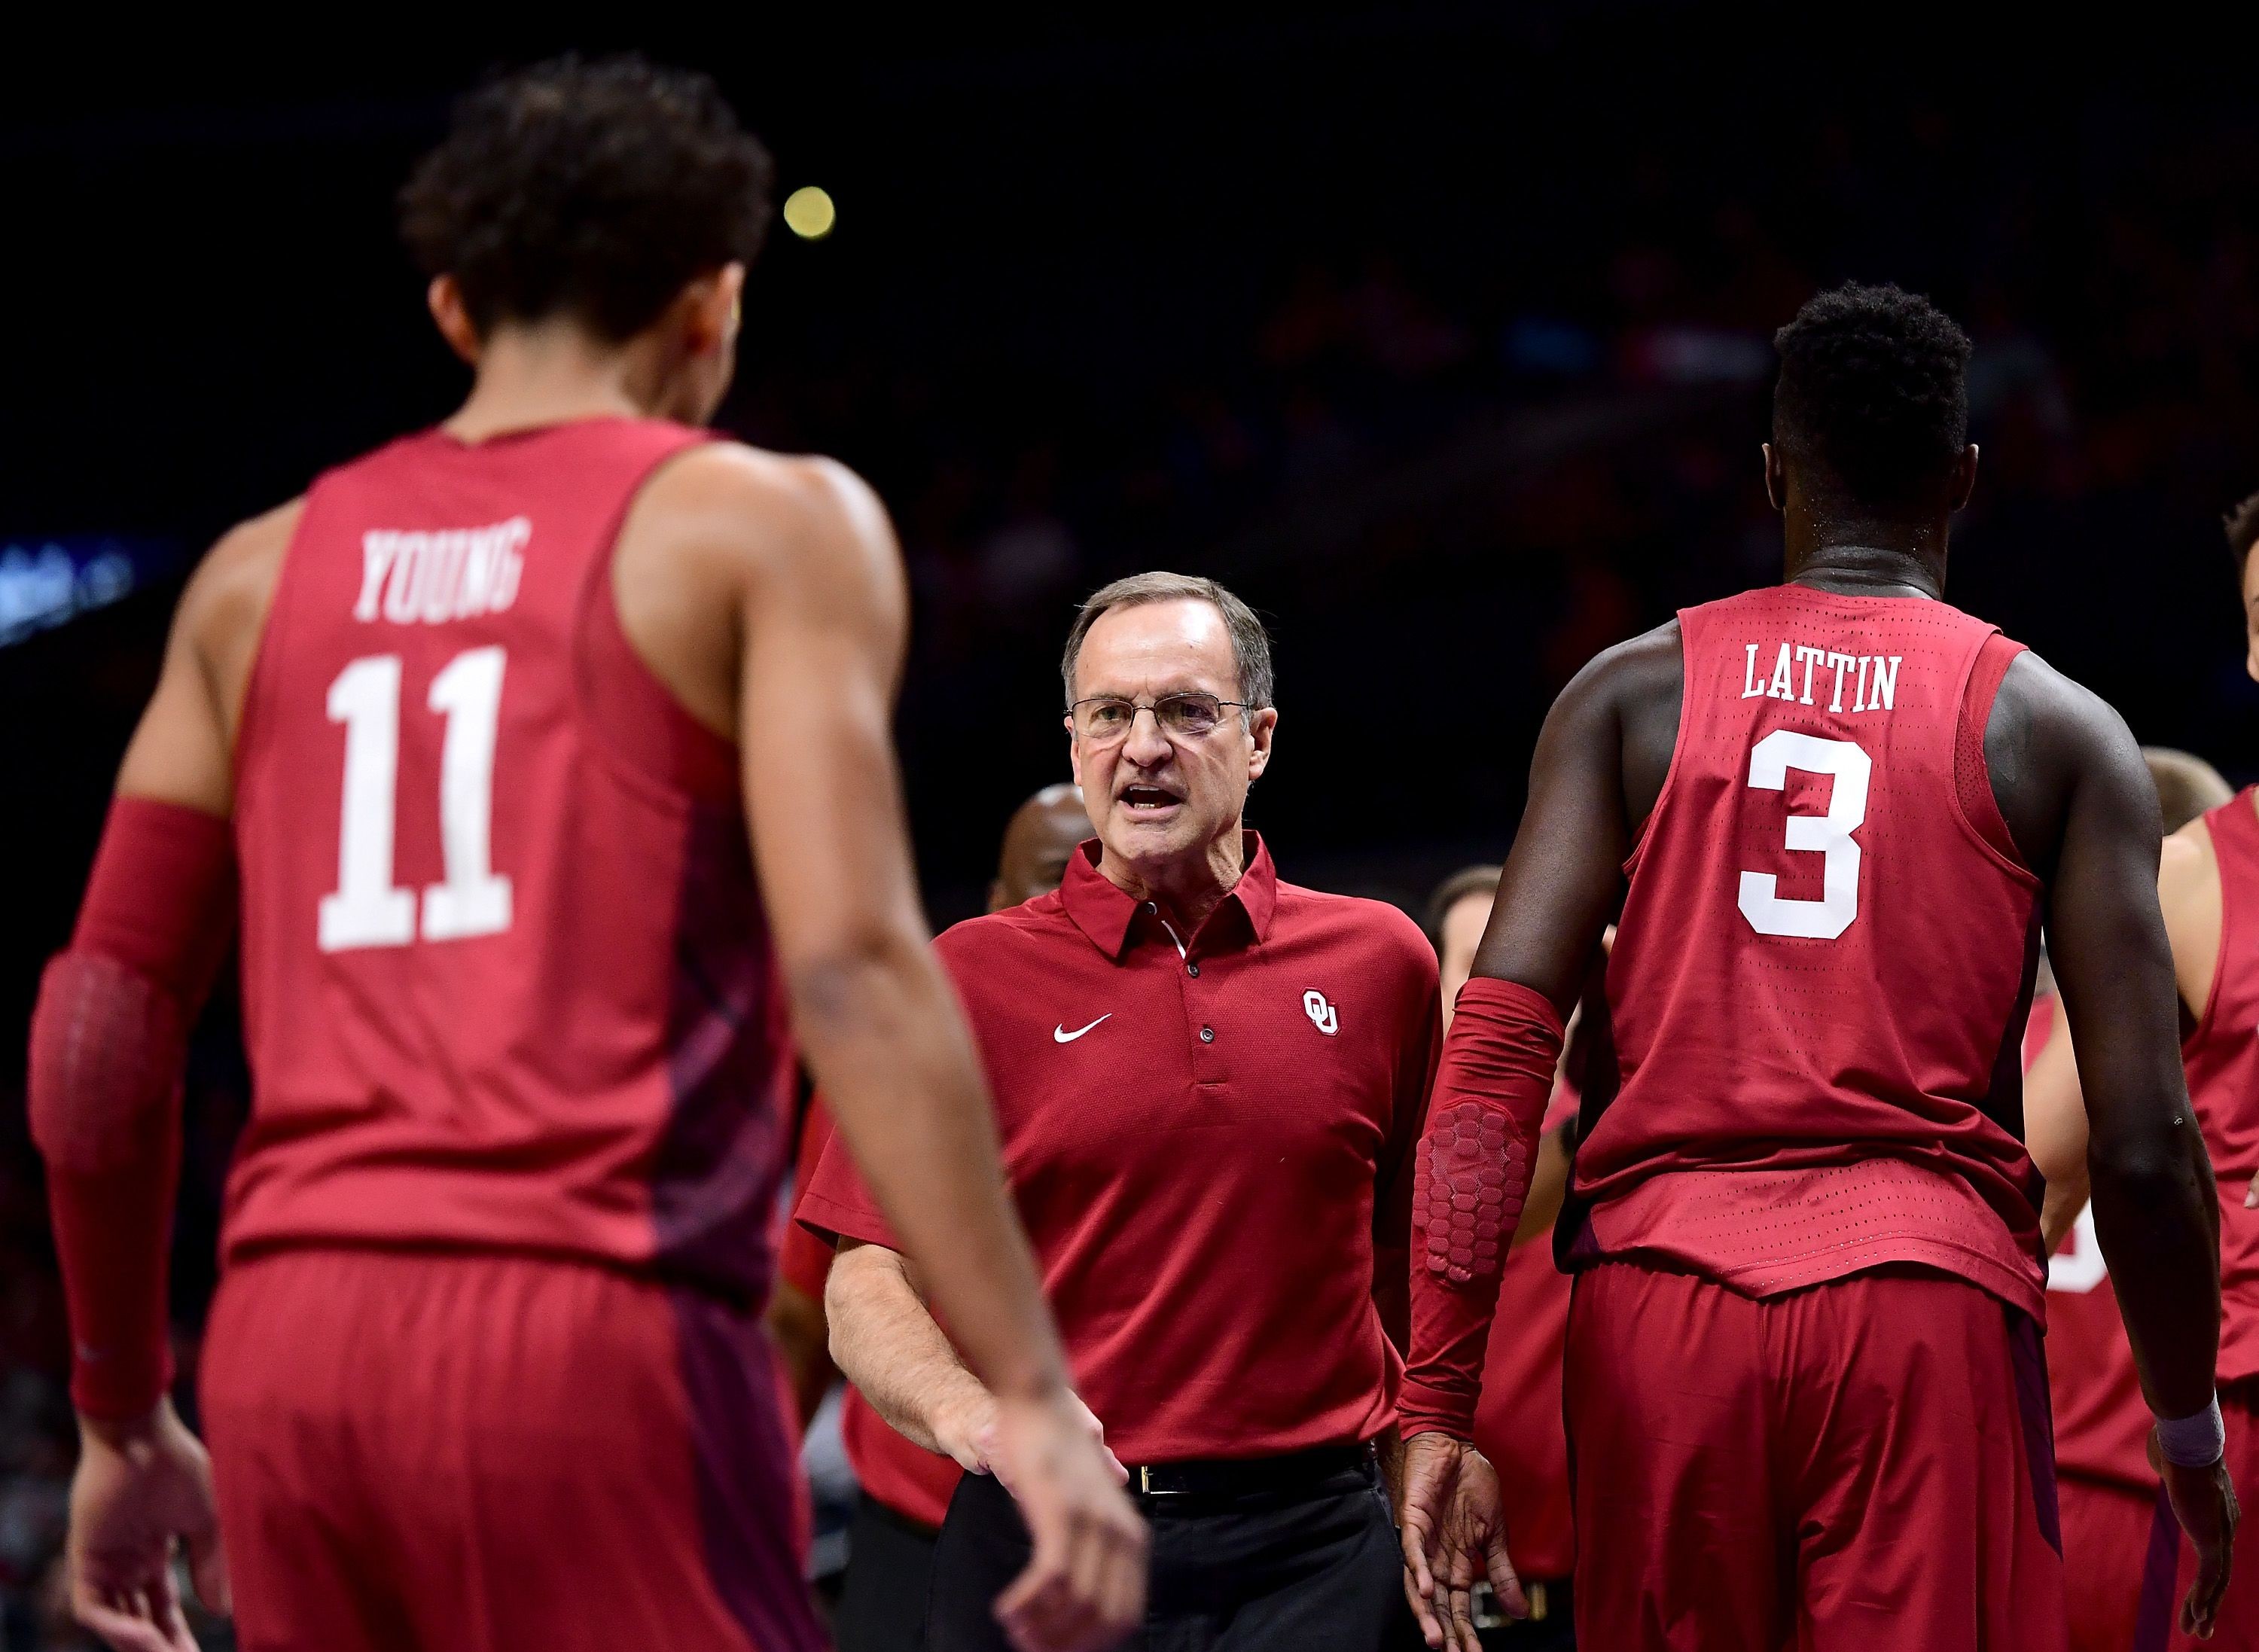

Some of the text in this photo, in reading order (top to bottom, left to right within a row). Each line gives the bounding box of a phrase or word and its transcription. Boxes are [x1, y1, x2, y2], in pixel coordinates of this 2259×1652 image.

[354, 517, 532, 624] YOUNG
[1741, 642, 1903, 713] LATTIN
[317, 645, 514, 952] 11
[1737, 729, 1873, 940] 3
[1302, 989, 1339, 1035] OU
